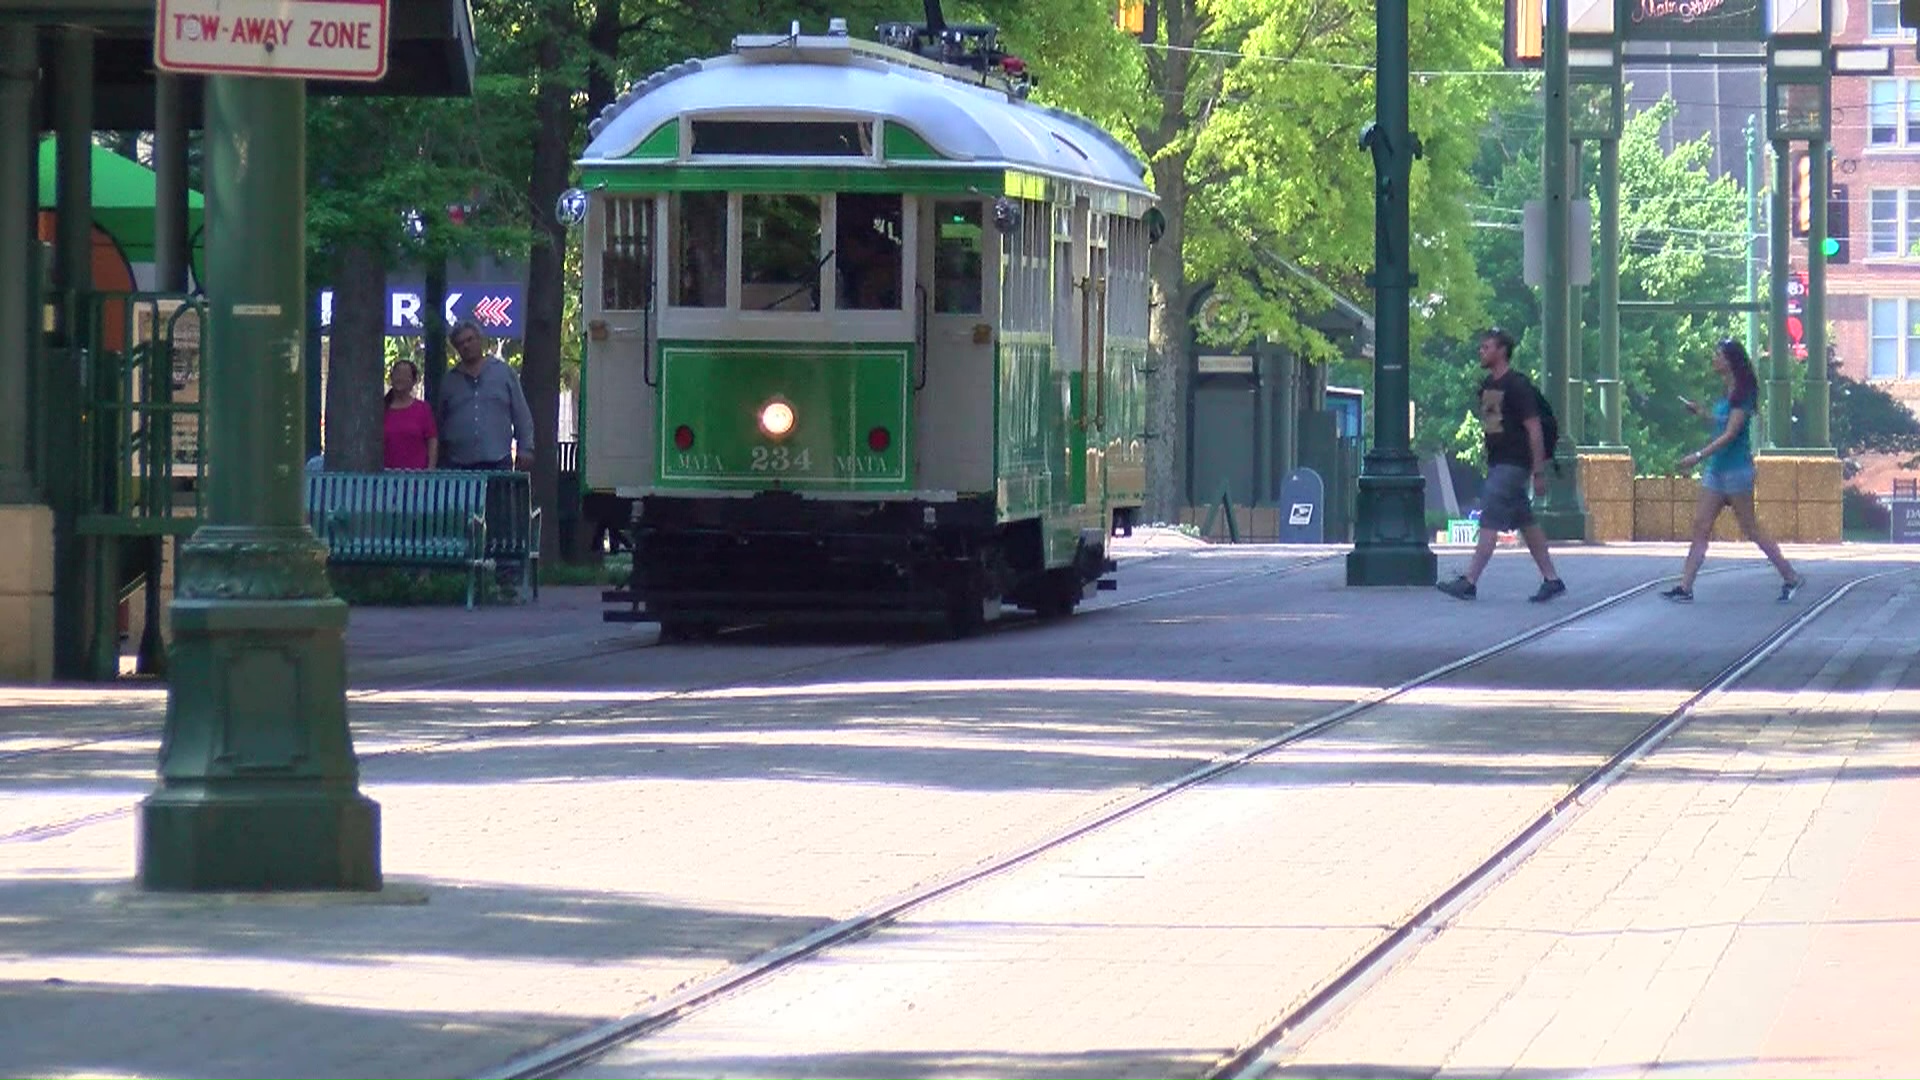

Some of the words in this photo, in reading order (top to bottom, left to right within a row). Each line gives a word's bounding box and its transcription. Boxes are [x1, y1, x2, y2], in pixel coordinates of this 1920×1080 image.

[173, 14, 294, 46] TOW-AWAY
[307, 20, 372, 50] ZONE
[751, 446, 812, 471] 234
